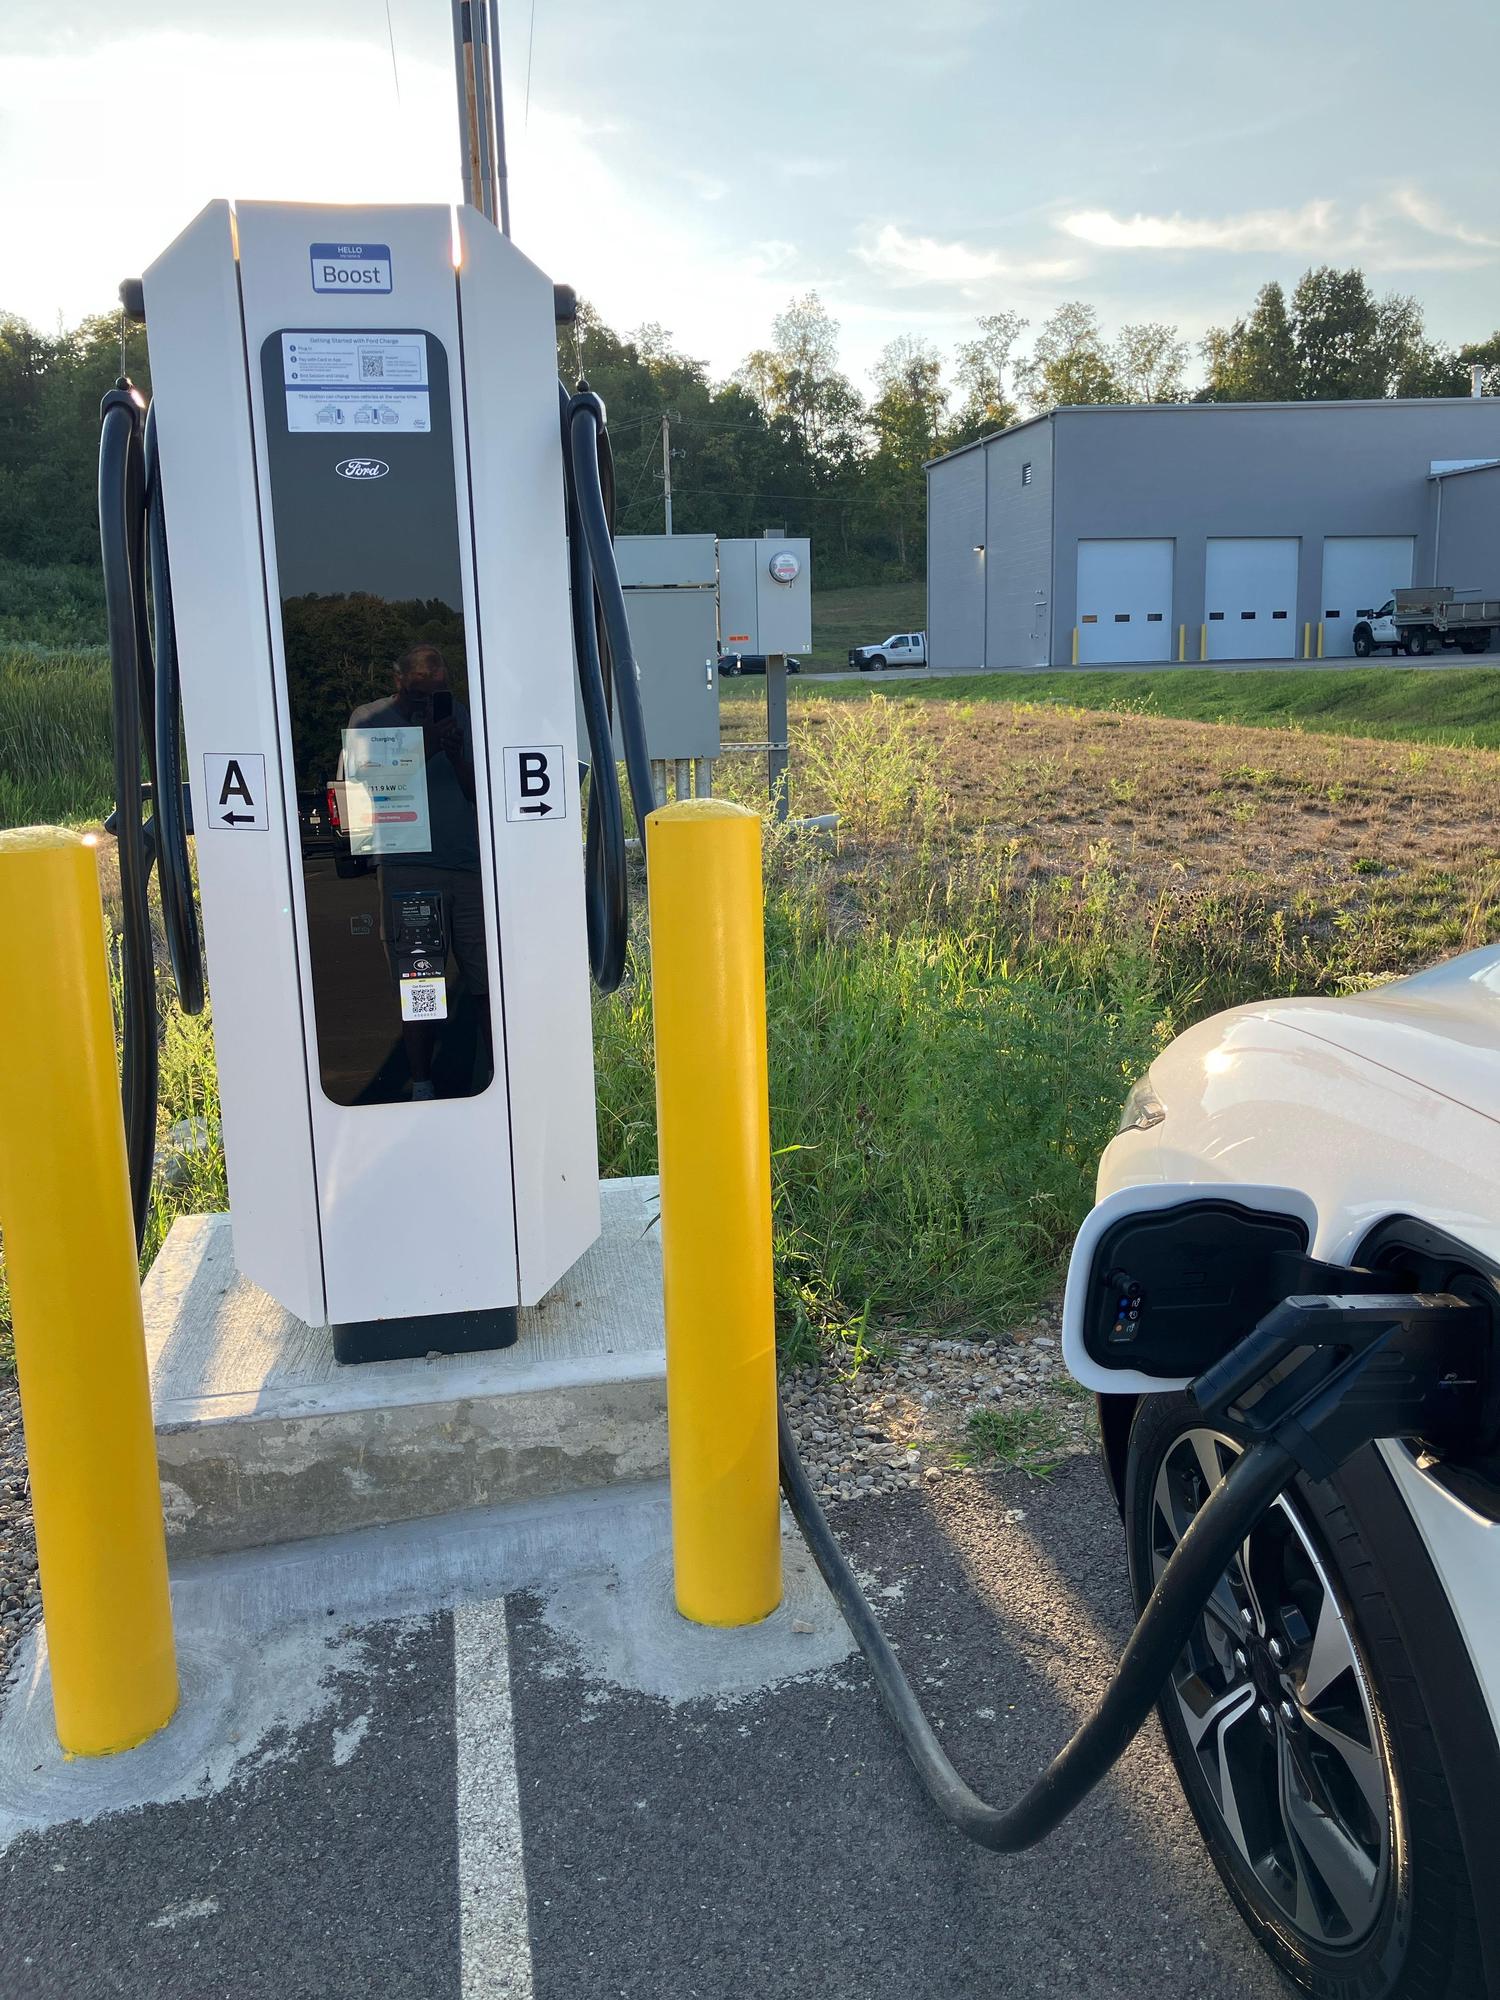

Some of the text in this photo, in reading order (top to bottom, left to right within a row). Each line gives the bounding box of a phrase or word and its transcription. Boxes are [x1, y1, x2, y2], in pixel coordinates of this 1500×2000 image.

[337, 246, 363, 254] HELLO
[323, 266, 381, 284] Boost
[345, 461, 380, 476] Ford
[218, 760, 255, 806] A
[519, 752, 551, 798] B
